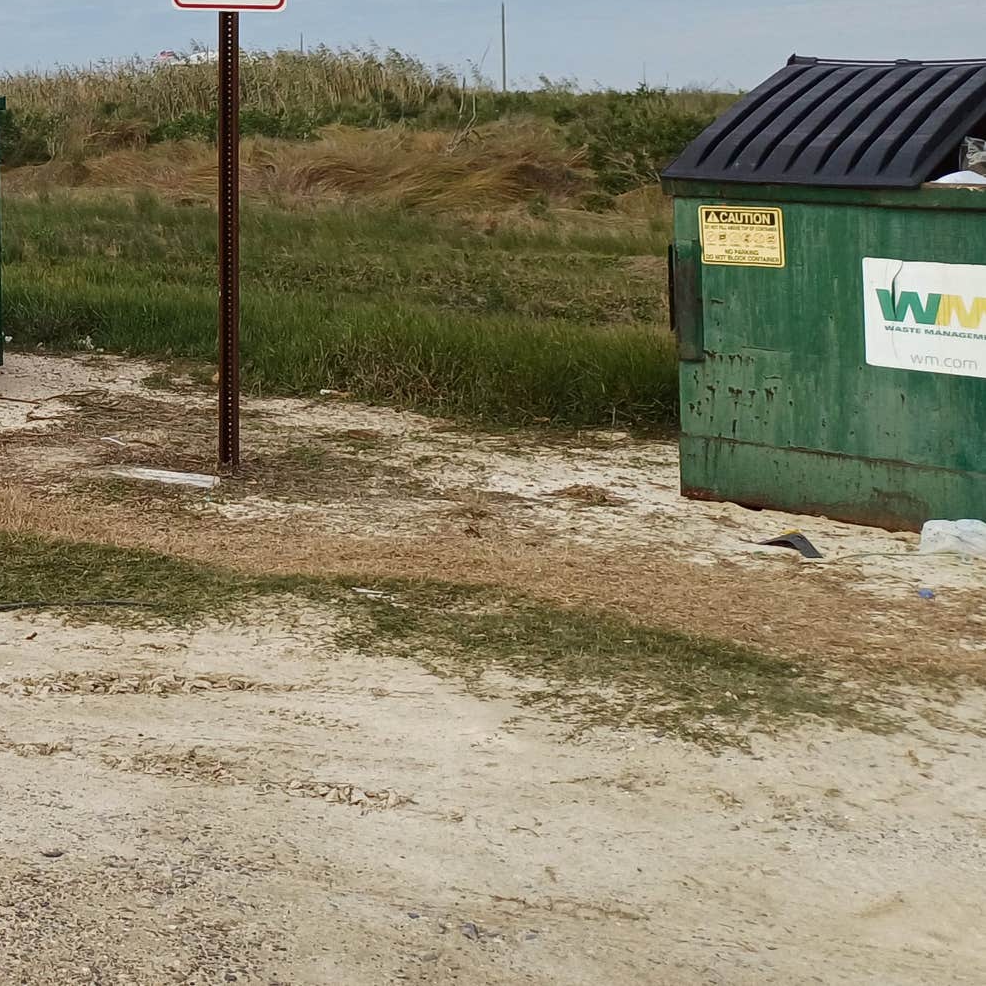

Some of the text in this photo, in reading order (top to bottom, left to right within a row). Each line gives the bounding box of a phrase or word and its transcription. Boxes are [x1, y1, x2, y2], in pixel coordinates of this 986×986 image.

[719, 211, 771, 225] CAUTION
[875, 288, 986, 329] WM
[884, 325, 921, 334] WASTE
[910, 354, 978, 371] wm.com
